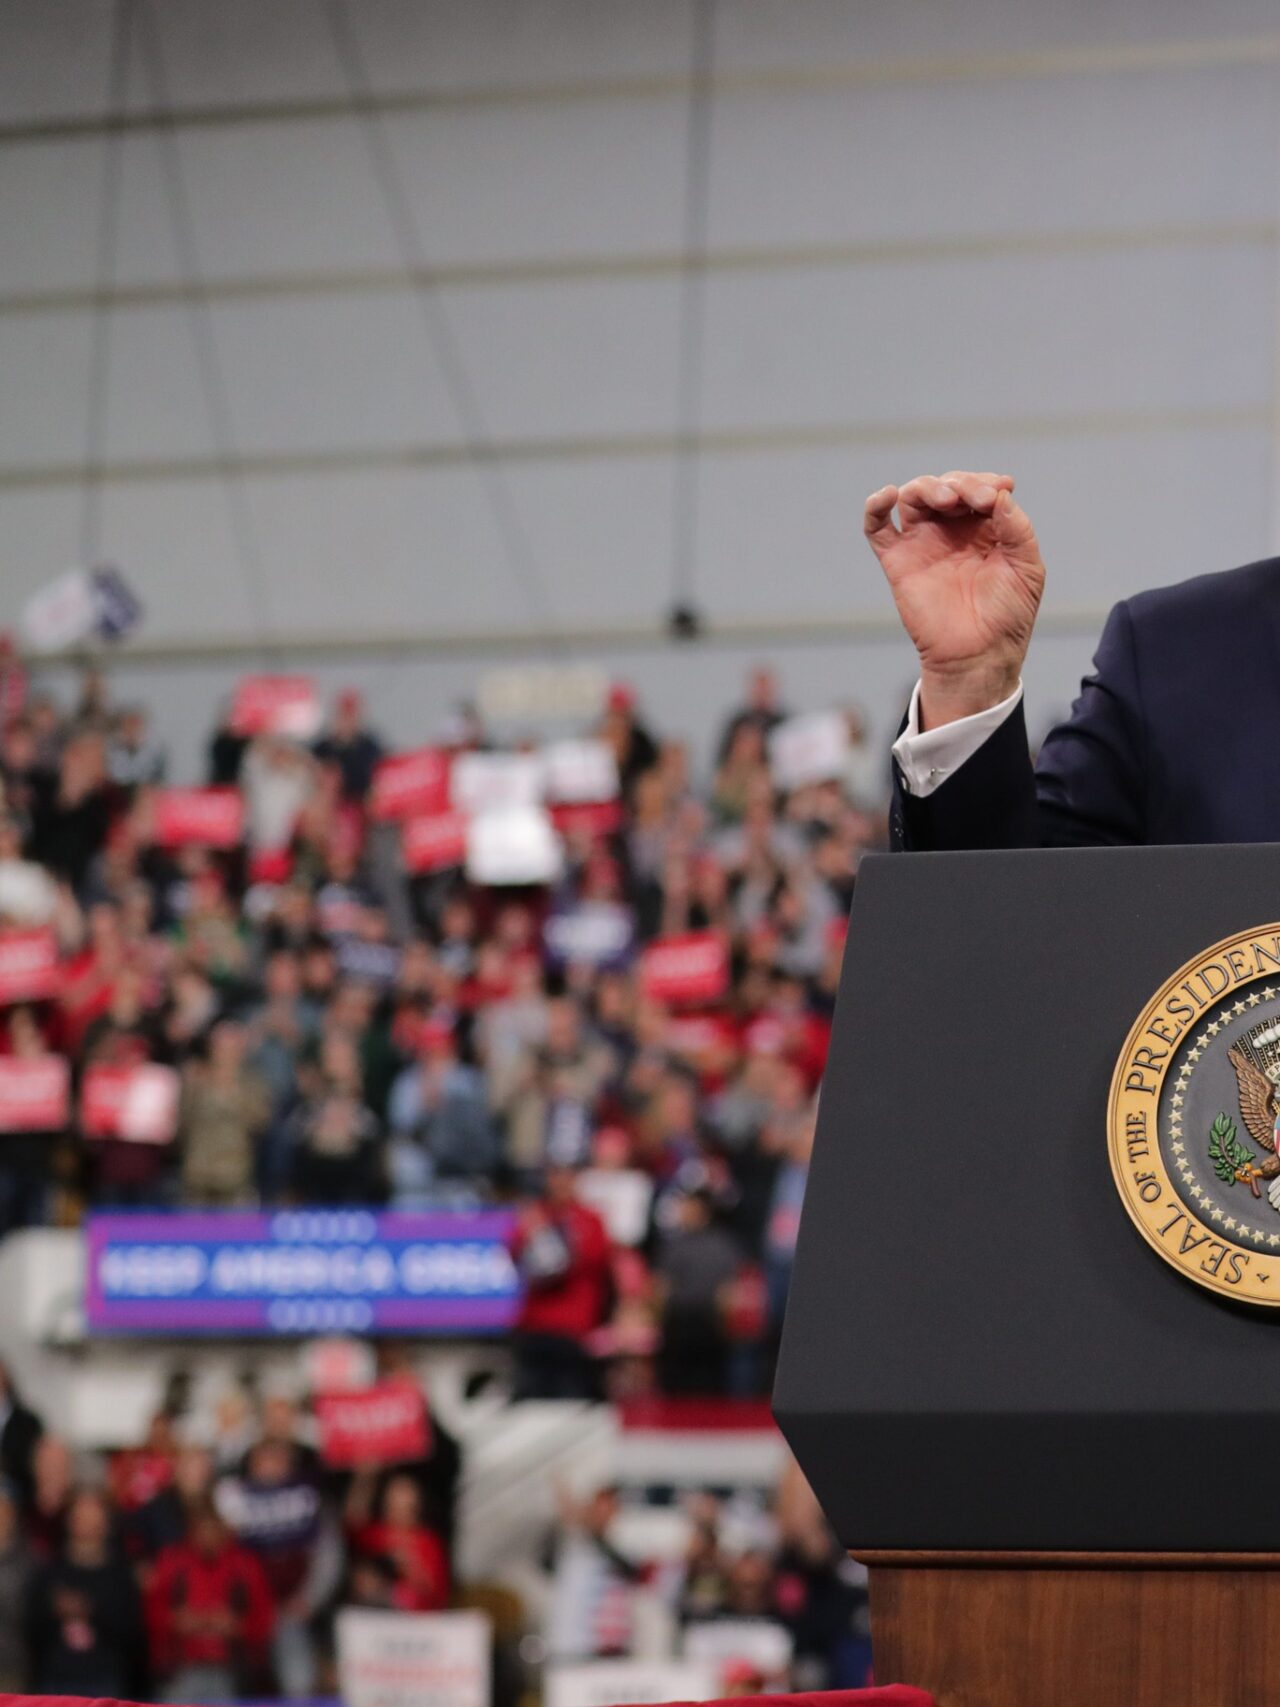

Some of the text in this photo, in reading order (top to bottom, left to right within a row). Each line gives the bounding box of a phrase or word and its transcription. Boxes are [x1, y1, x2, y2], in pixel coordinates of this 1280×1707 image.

[1268, 1069, 1276, 1077] E
[1125, 1110, 1153, 1165] THE
[1132, 1170, 1163, 1204] OF
[1156, 1202, 1251, 1285] SEAL
[101, 1244, 519, 1295] KEEP AMERICA GREA
